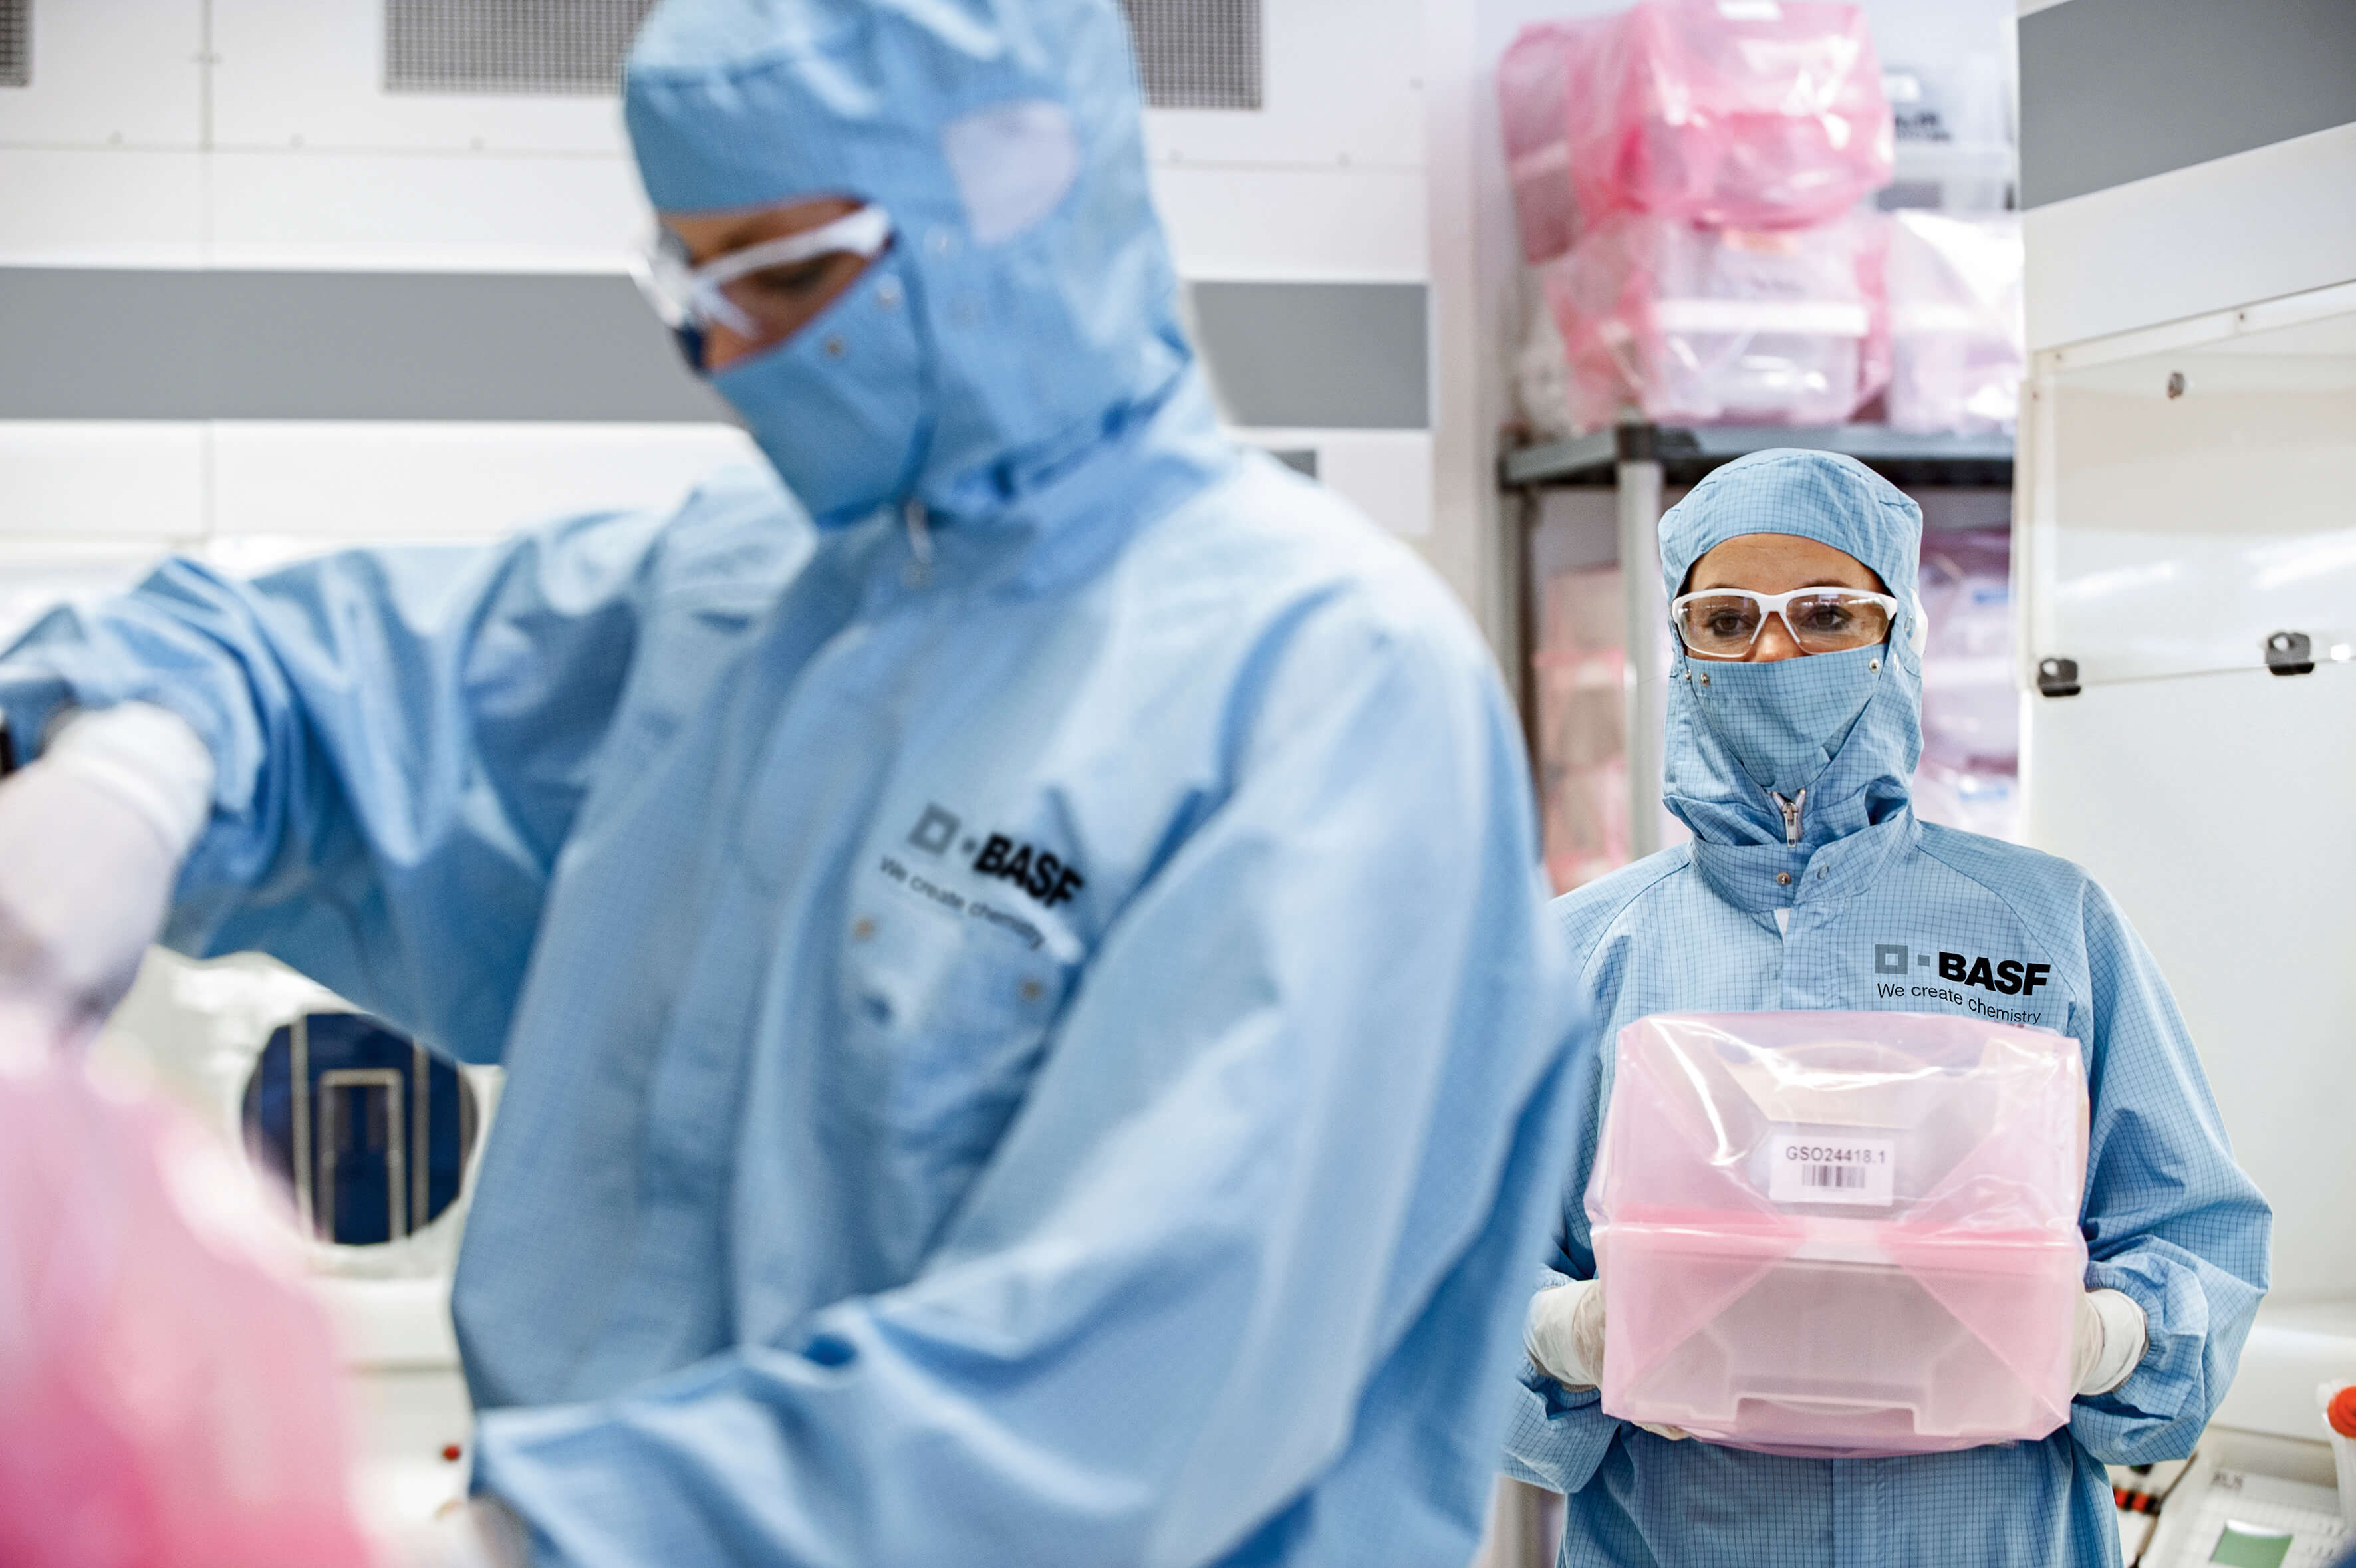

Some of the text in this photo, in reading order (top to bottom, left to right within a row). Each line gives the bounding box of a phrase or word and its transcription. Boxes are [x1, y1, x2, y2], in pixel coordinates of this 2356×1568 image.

[880, 856, 907, 882] We
[910, 876, 964, 910] create
[972, 832, 1085, 908] BASF
[1939, 951, 2051, 995] BASF
[1877, 983, 2041, 1024] We create chemistry
